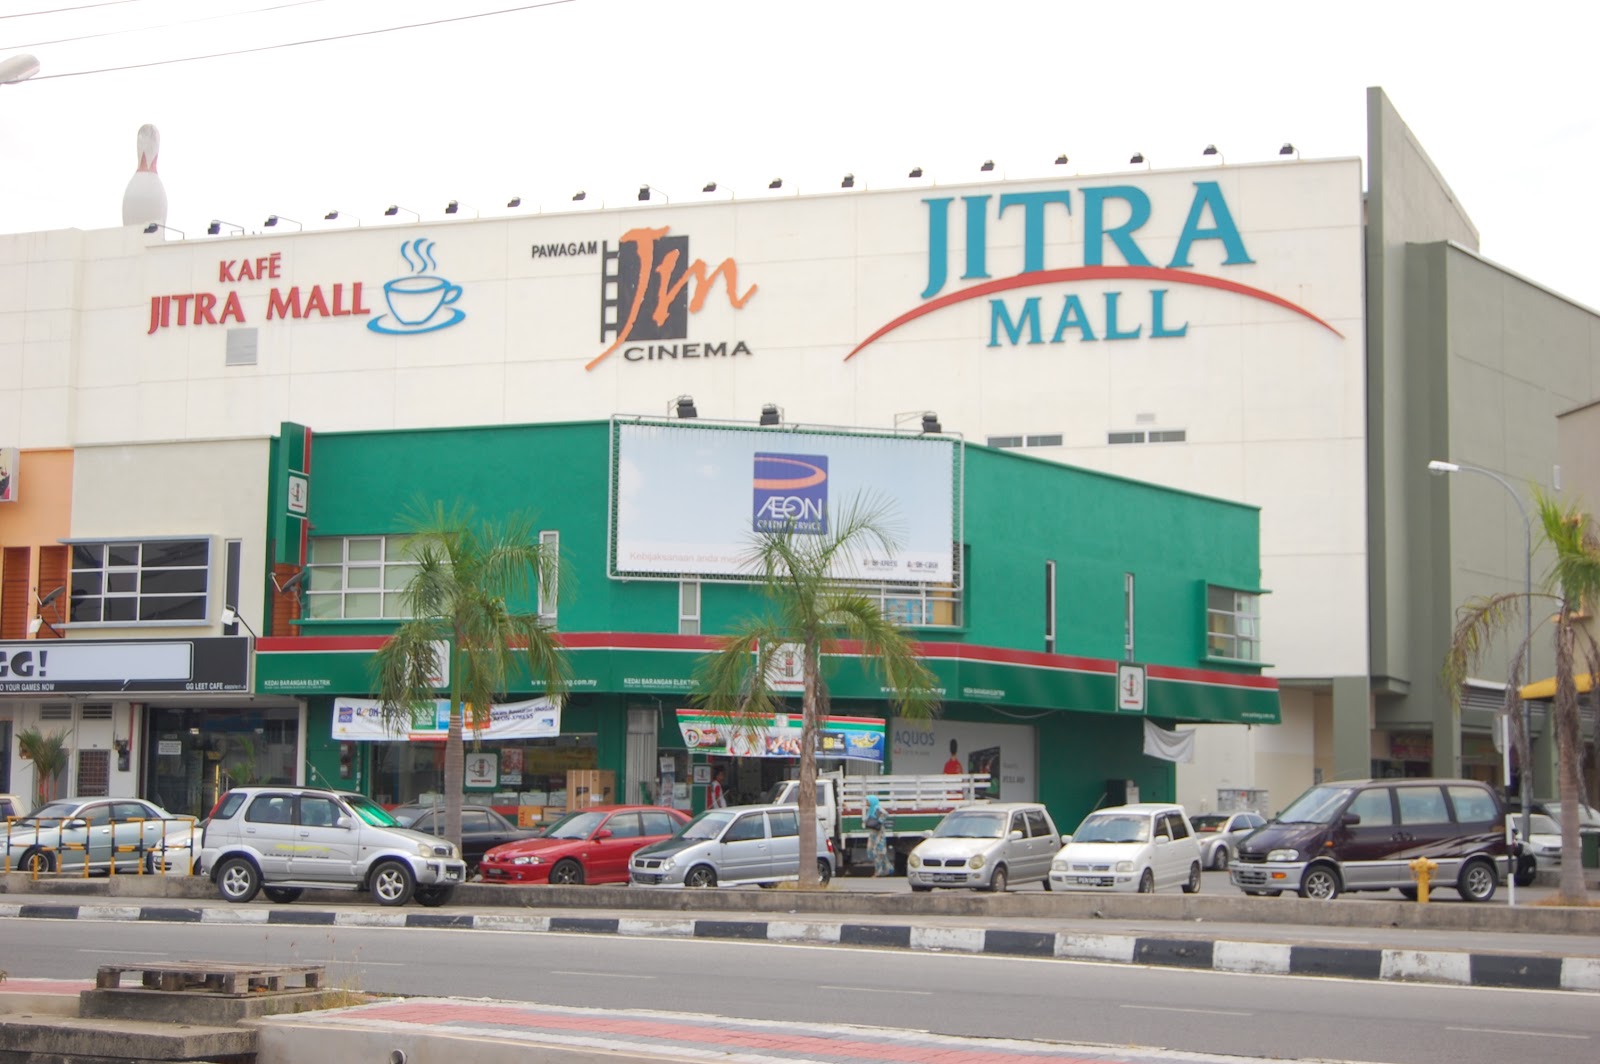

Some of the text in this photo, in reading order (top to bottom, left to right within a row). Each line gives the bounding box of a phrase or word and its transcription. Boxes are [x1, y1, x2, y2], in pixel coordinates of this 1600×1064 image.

[531, 240, 598, 259] PAWAGAM
[921, 181, 1256, 299] JITRA
[147, 282, 371, 335] JITRA MALL
[986, 289, 1189, 348] MALL
[623, 340, 753, 362] CINEMA
[5, 682, 21, 692] YOUR
[21, 682, 40, 692] GAMES
[41, 682, 55, 691] NOW
[194, 682, 209, 691] LEET
[209, 682, 224, 690] CAFE
[641, 678, 673, 686] BARANGAN
[893, 730, 935, 747] AQUOS
